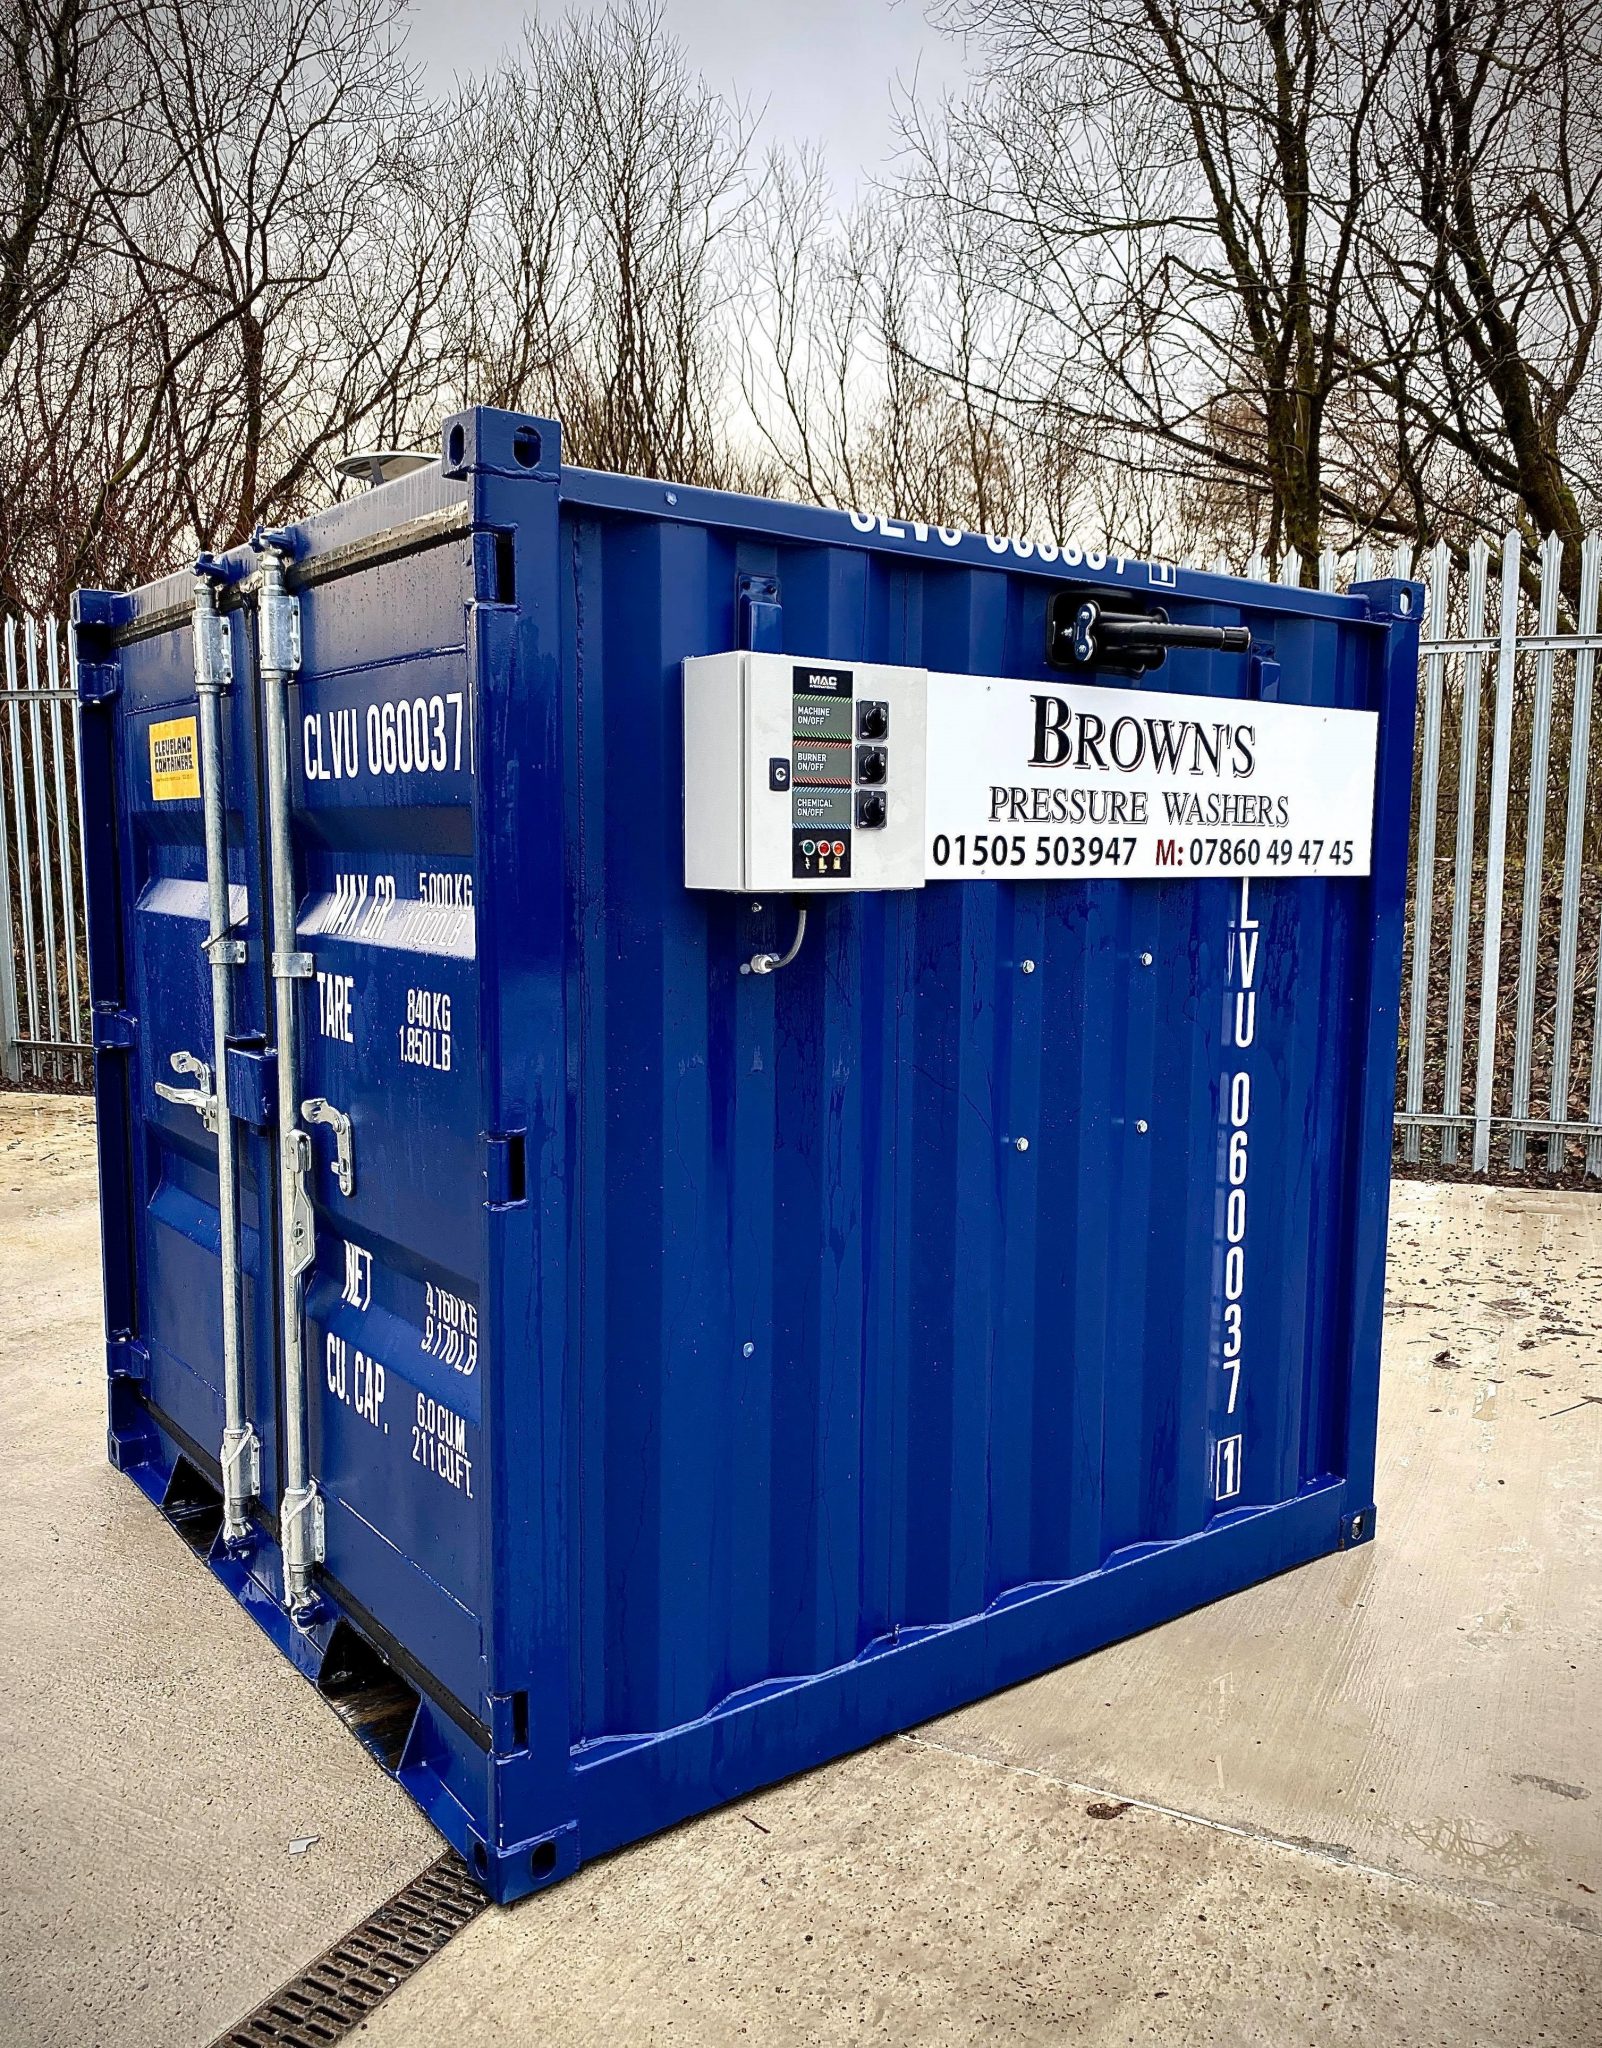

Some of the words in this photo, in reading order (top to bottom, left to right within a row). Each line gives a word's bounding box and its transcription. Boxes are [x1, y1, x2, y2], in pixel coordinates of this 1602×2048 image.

[809, 675, 837, 686] MAC
[797, 706, 831, 717] MACHINE
[797, 715, 825, 725] ON/OFF
[304, 708, 359, 780] CLVU
[366, 692, 463, 775] 060037
[1028, 694, 1256, 778] BROWN'S
[154, 736, 192, 757] CLEVELAND
[155, 754, 194, 773] CONTAINERS
[797, 752, 827, 762] BURNER
[797, 762, 825, 772] ON/OFF
[797, 798, 833, 808] CHEMICAL
[797, 807, 824, 817] ON/OFF
[988, 786, 1149, 825] PRESSURE
[1162, 791, 1290, 827] WASHERS
[932, 835, 1026, 866] 01505
[1035, 837, 1138, 866] 503947
[1156, 839, 1184, 867] M:
[1190, 838, 1261, 866] 07860
[1266, 839, 1293, 866] 49
[1298, 840, 1324, 866] 47
[1329, 840, 1355, 866] 45
[316, 971, 354, 1043] TARE
[1222, 1071, 1251, 1414] 060037
[341, 1240, 374, 1312] NET
